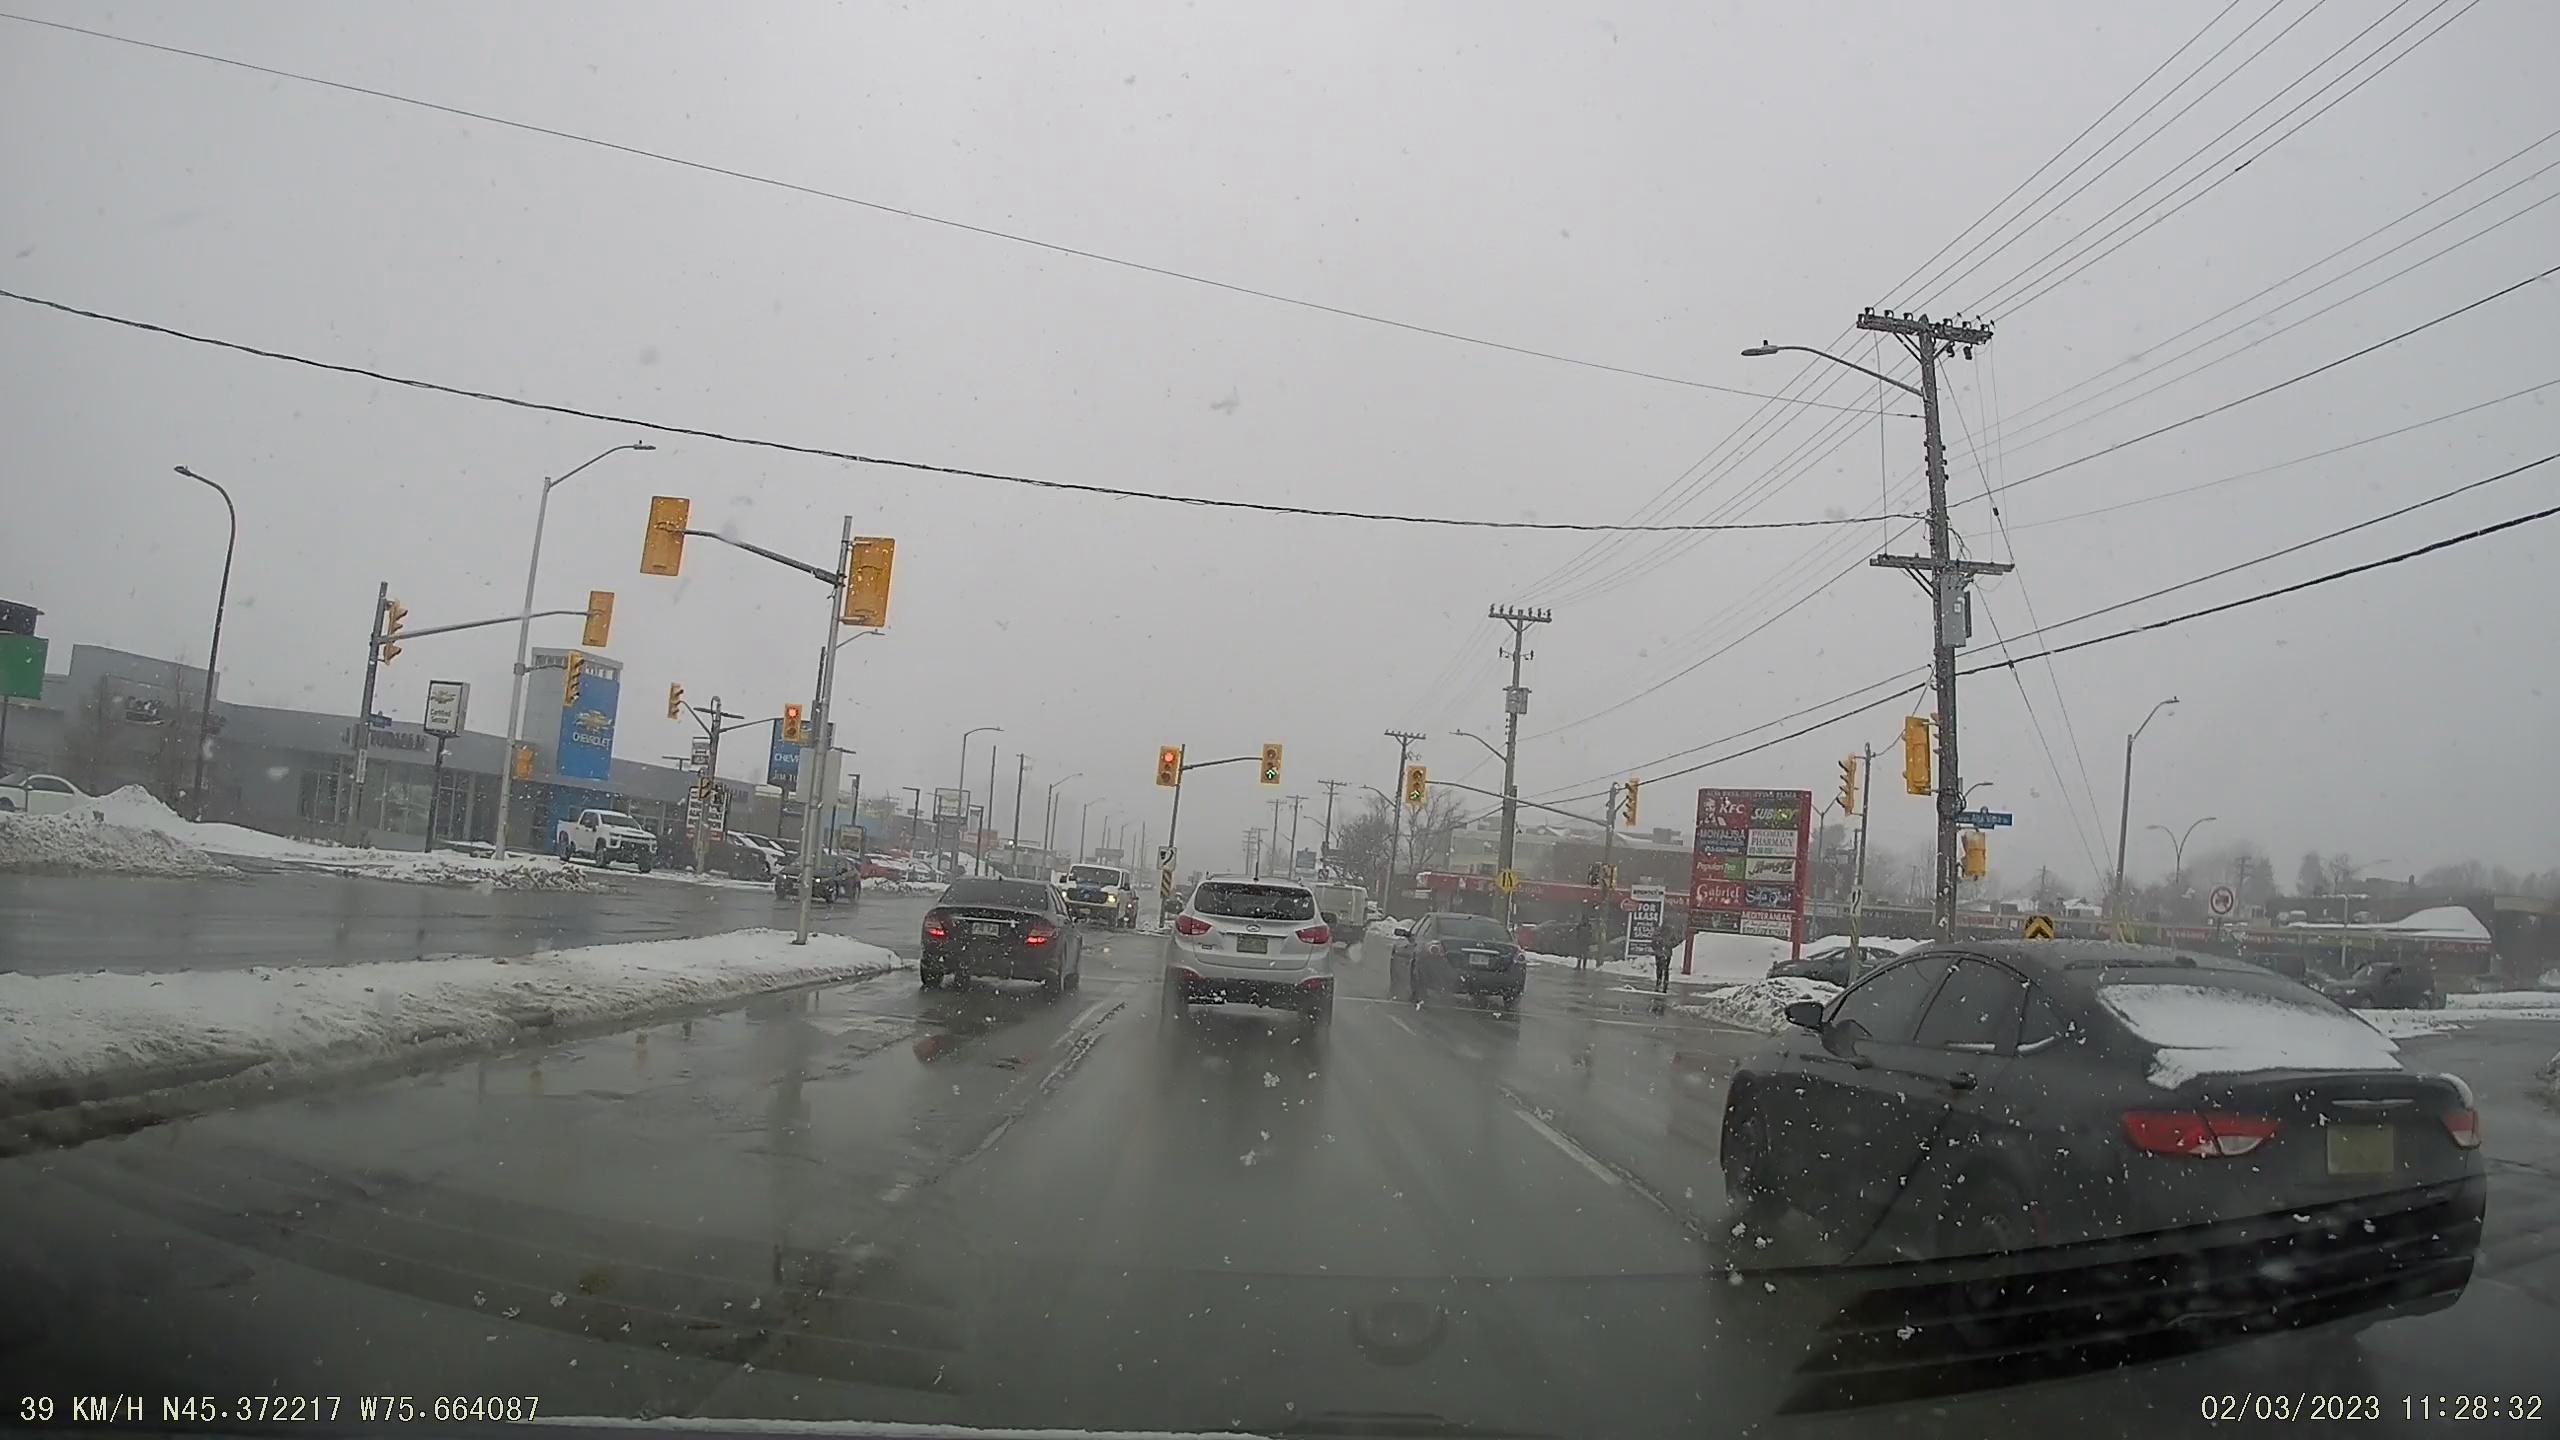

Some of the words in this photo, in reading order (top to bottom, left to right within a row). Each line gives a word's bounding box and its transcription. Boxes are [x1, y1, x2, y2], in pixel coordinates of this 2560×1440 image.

[1719, 803, 1745, 814] KFC
[1697, 884, 1742, 898] Gabriel
[1637, 903, 1656, 912] FOR
[1633, 912, 1659, 922] LEASE
